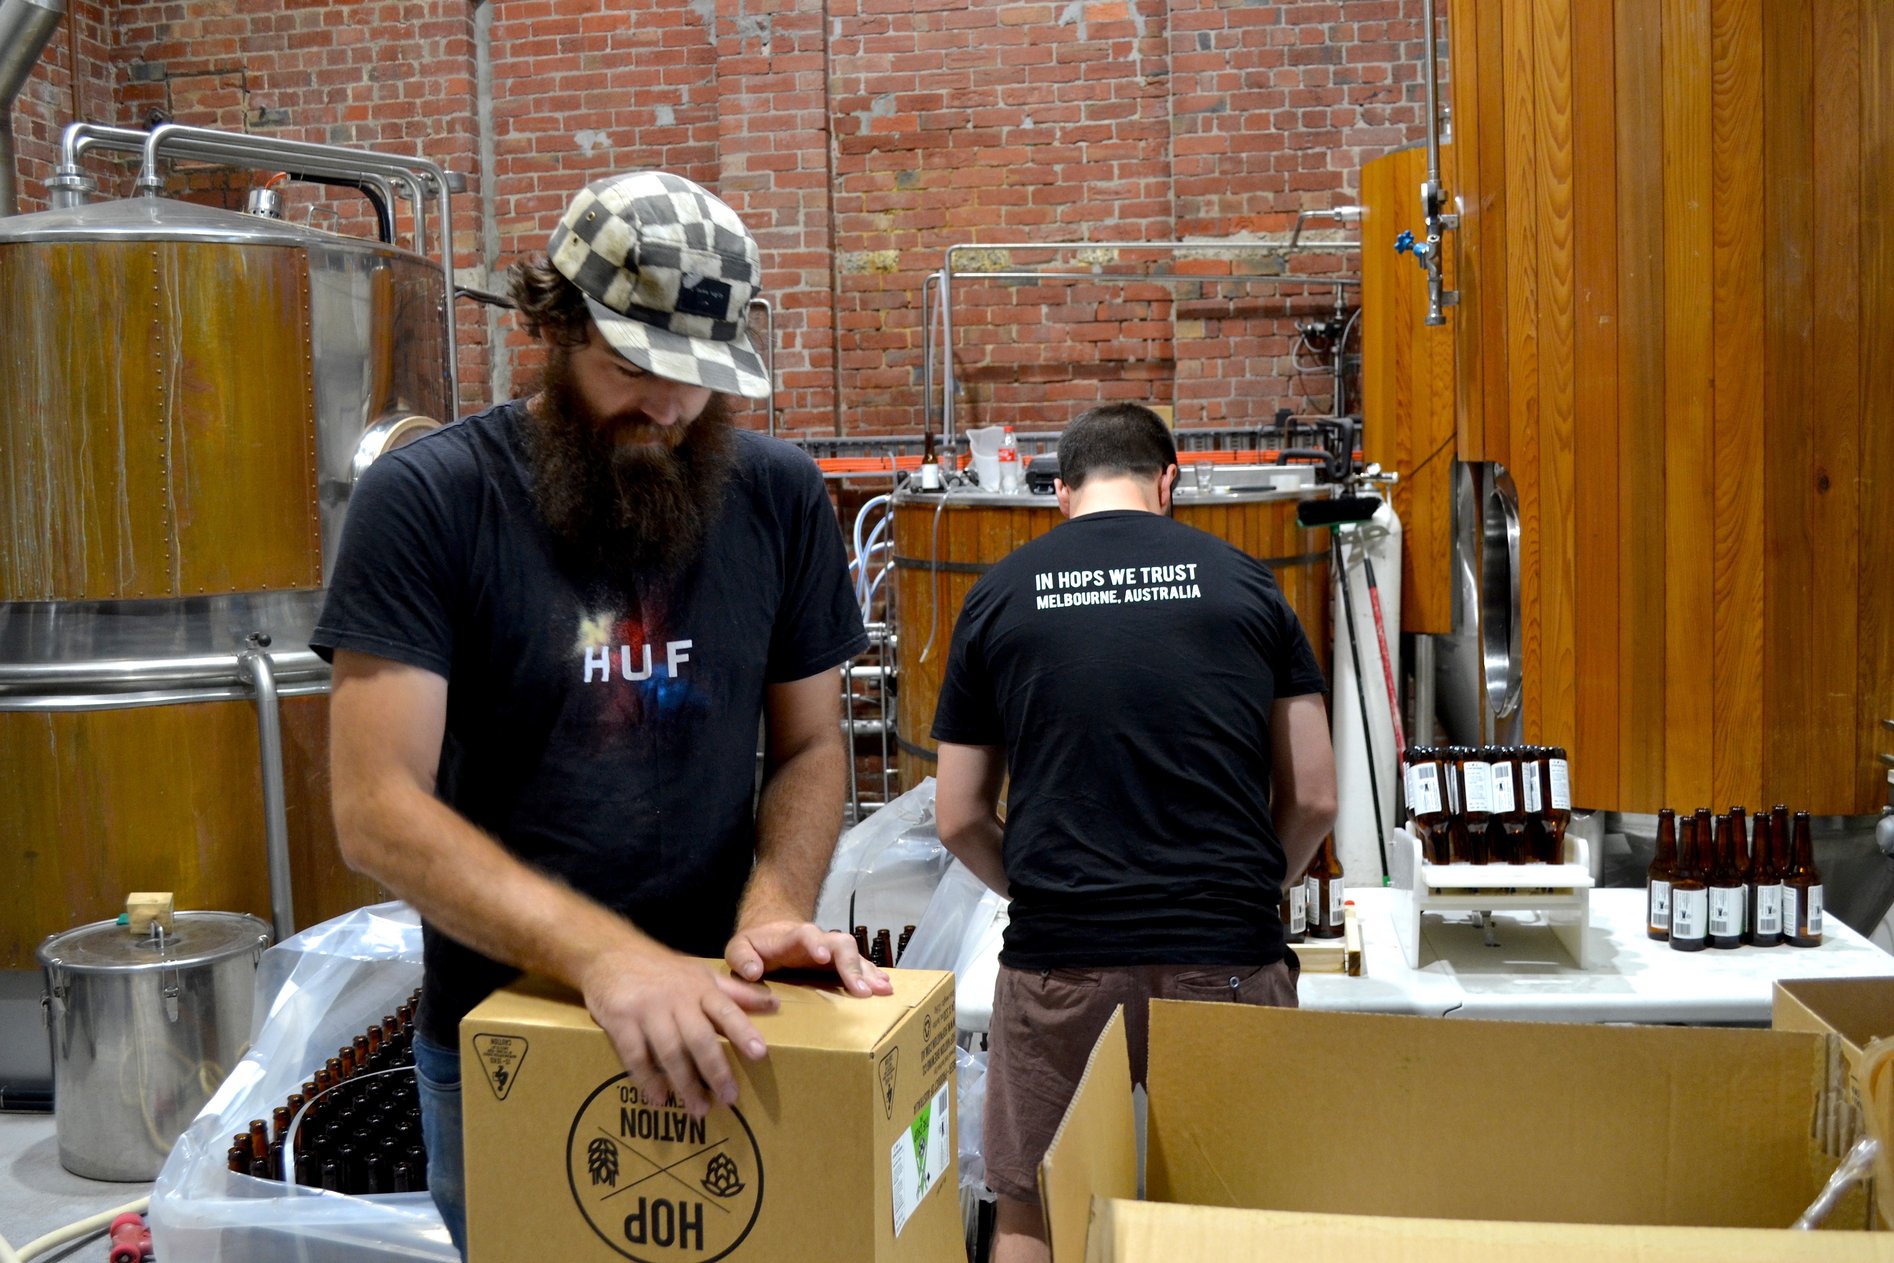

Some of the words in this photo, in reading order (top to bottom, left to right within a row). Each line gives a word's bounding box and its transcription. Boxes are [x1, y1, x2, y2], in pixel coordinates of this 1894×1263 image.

[1035, 572, 1054, 591] IN
[1058, 569, 1105, 589] HOPS
[1109, 567, 1137, 586] WE
[1140, 563, 1197, 584] TRUST
[1036, 590, 1122, 610] MELBOURNE,
[1124, 584, 1202, 603] AUSTRALIA
[583, 639, 693, 683] HUF
[620, 1106, 706, 1145] NATION
[623, 1196, 704, 1251] HOP
